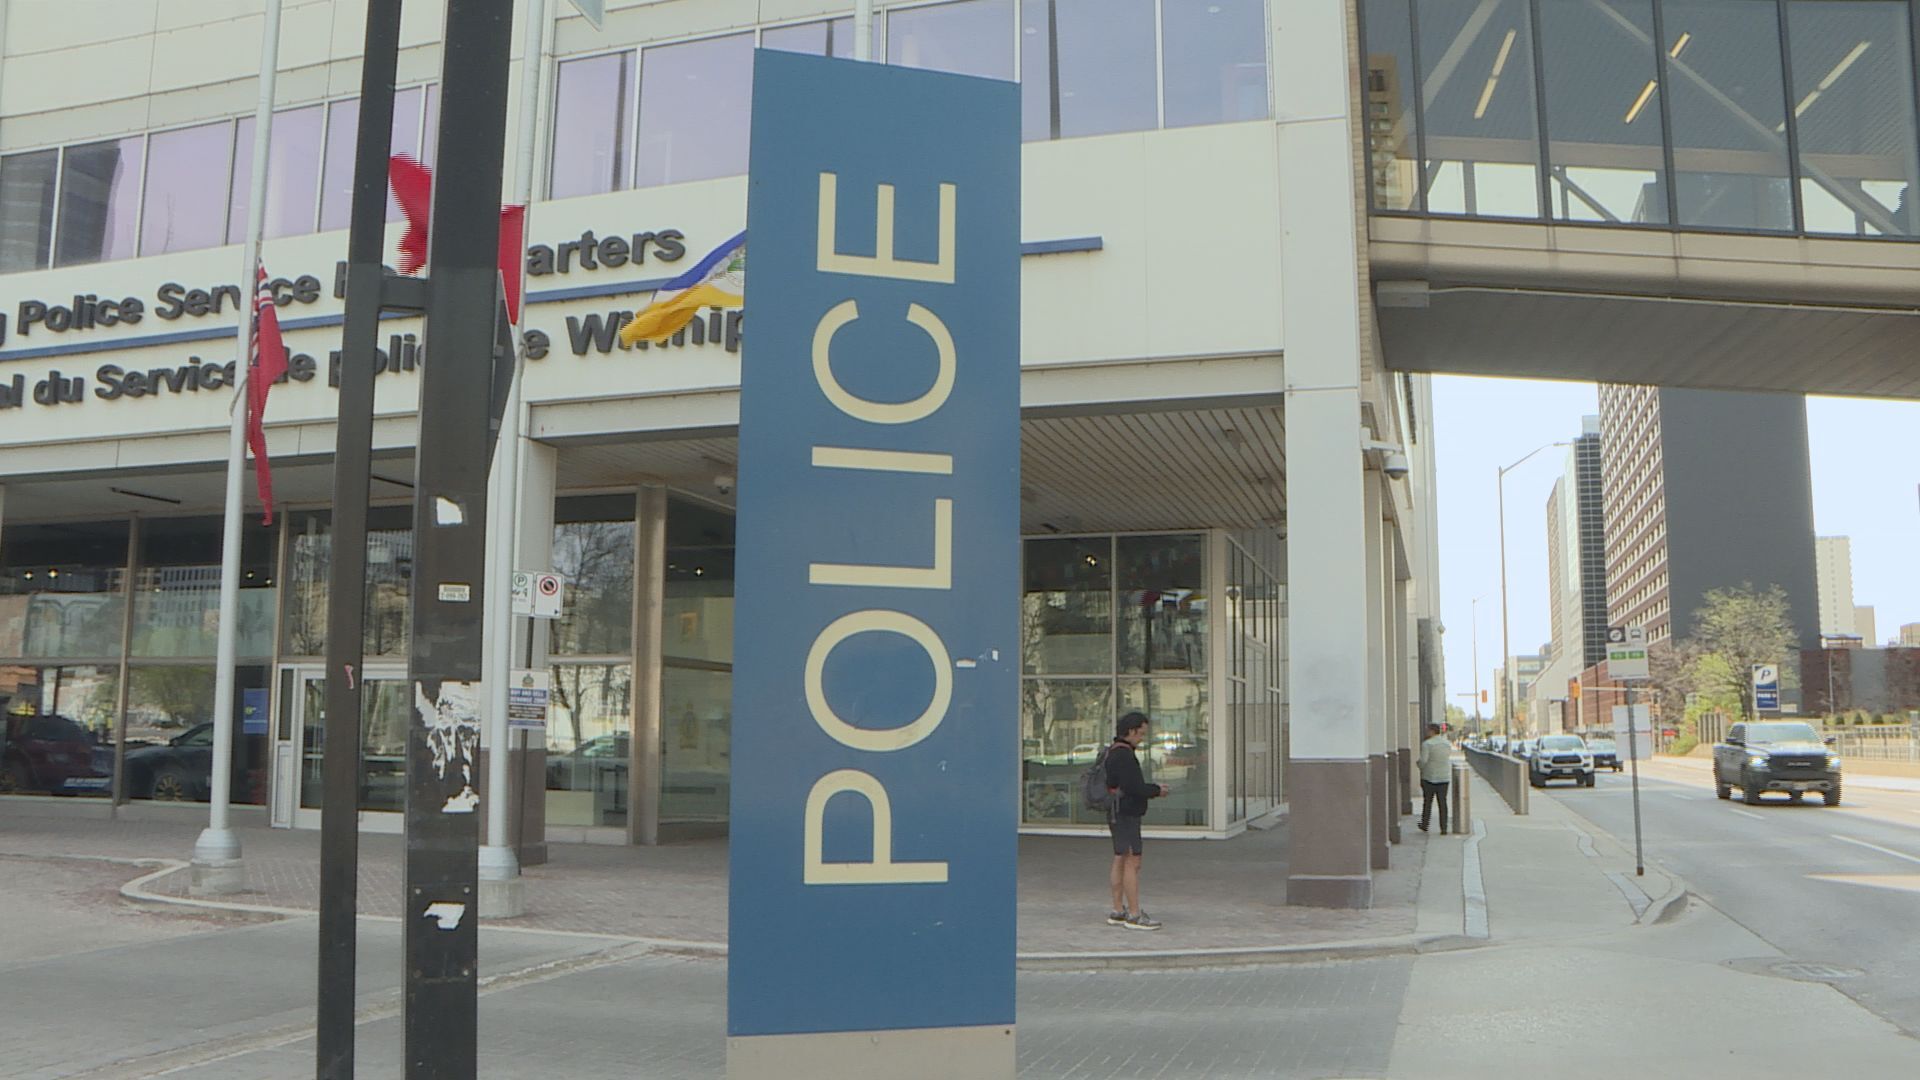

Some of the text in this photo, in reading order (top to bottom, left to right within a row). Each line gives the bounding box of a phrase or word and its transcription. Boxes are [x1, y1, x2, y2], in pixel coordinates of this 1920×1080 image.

[17, 294, 144, 336] Police
[155, 275, 321, 320] Serce
[33, 370, 85, 405] du
[804, 171, 957, 886] POLICE
